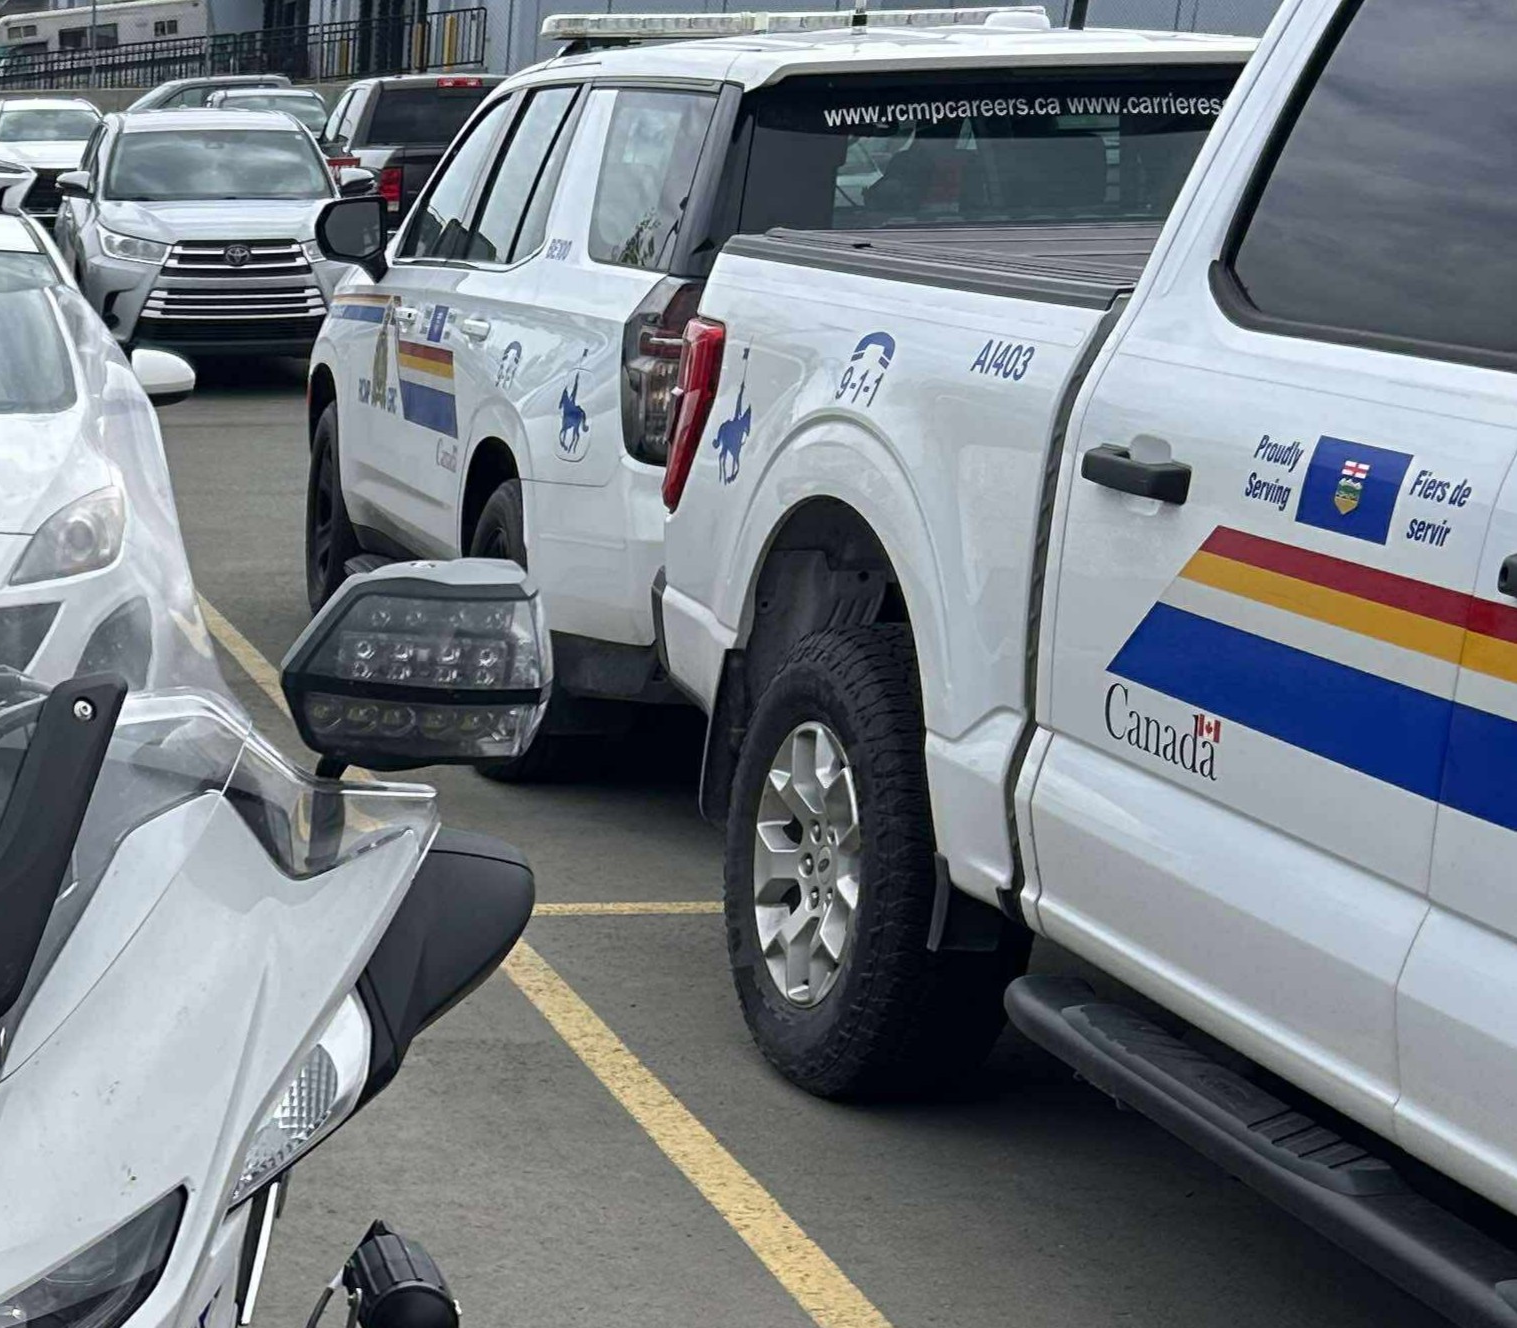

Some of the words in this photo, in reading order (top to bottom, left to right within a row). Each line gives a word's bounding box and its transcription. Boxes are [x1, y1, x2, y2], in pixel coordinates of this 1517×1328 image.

[823, 97, 1061, 127] www.rcmpcareers.ca
[1067, 92, 1228, 116] www.carrieres
[970, 338, 1035, 381] AI403
[834, 365, 884, 408] 9-1-1
[1253, 434, 1305, 473] Proudly
[1244, 472, 1292, 512] Serving
[1408, 469, 1451, 502] Fiers
[1448, 478, 1473, 508] de
[1405, 517, 1452, 548] servir
[1104, 682, 1218, 782] Canada
